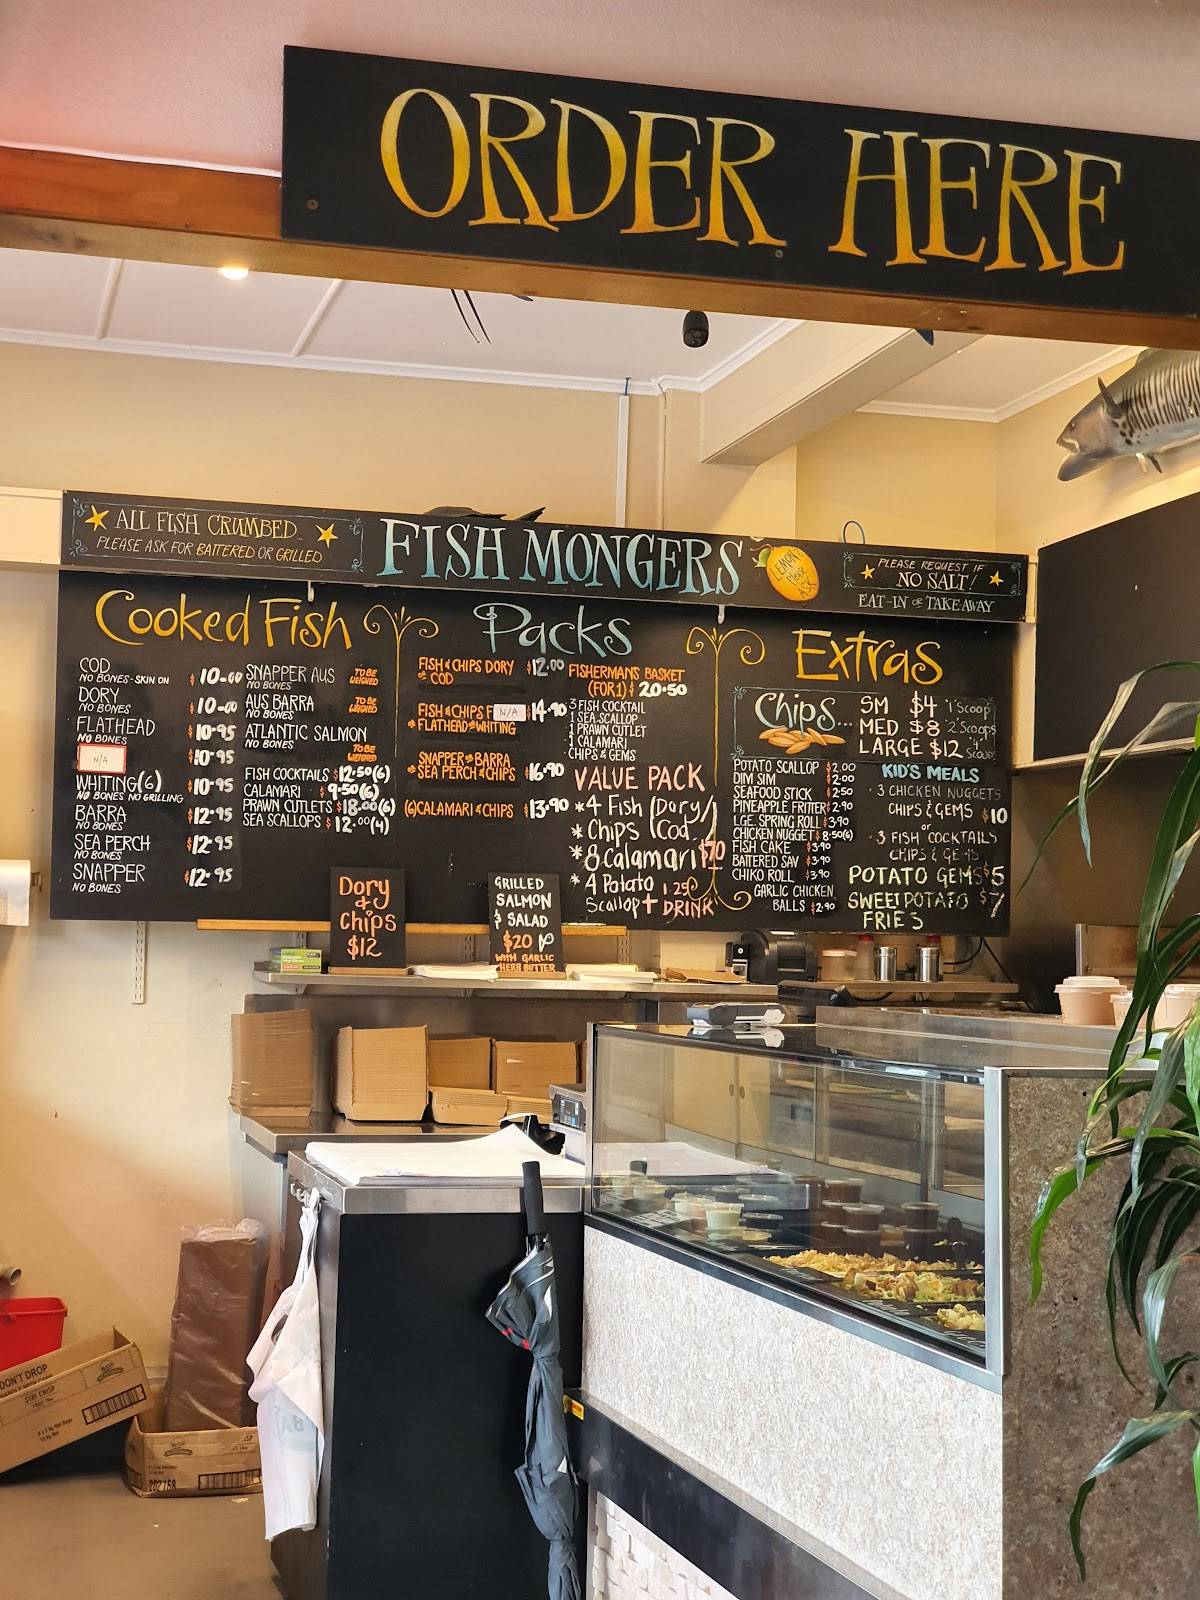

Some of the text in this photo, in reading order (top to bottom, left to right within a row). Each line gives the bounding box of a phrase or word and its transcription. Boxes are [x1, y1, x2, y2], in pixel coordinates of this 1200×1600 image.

[380, 88, 1124, 276] ORDER HERE
[115, 509, 150, 531] ALL
[157, 511, 200, 535] FISH
[97, 536, 322, 564] PLEASE ASK FOR BATTERED OR GRILLED
[376, 518, 743, 597] FISH MONGERS
[877, 558, 985, 572] PLEASE REQUEST IF
[896, 571, 976, 594] NO SALT!
[926, 596, 996, 612] TAKEAWAY
[96, 590, 352, 649] Cooked Fish
[473, 603, 632, 657] Packs
[792, 628, 943, 685] Extras
[80, 658, 110, 674] COD
[246, 664, 335, 684] SNAPPER AUS
[419, 657, 514, 676] FISH CHIPS DORY
[569, 664, 685, 682] FISHERMANS BASKET
[79, 674, 169, 684] NO ON
[263, 681, 292, 690] BONES
[431, 672, 454, 685] COD
[79, 687, 120, 703] DORY
[246, 694, 314, 711] AUS BARRA
[79, 703, 131, 714] NO BONES
[418, 703, 443, 718] FISH
[451, 705, 484, 718] CHIPS
[579, 700, 646, 714] FISH COCKTAIL
[860, 690, 938, 718] SM $4
[263, 711, 294, 720] BONES
[499, 709, 518, 717] N/A
[577, 712, 638, 725] SEA SCALLOP
[77, 715, 155, 737] FLATHEAD
[245, 724, 367, 743] ATLANTIC SALMON
[577, 724, 647, 738] PRAWN CUTLET
[859, 718, 940, 736] MED $8
[77, 733, 128, 745] NO BONES
[262, 740, 294, 749] BONES
[578, 736, 627, 749] CALAMARI
[568, 748, 636, 761] CHIPS GEMS
[859, 737, 924, 758] LARGE
[929, 739, 963, 760] $12
[94, 754, 108, 764] N/A
[474, 752, 511, 767] BARRA
[733, 759, 819, 775] POTATO SCALLOP
[245, 767, 330, 782] FISH COCKTAILS
[418, 765, 516, 781] SEA PERCH CHIPS
[575, 762, 705, 792] VALUE PACK
[733, 772, 776, 788] DIM SIM
[926, 768, 980, 783] MEALS
[93, 792, 184, 803] BONES NO GRILLING
[244, 783, 300, 798] CALAMARI
[733, 785, 812, 801] SEAFOOD STICK
[889, 785, 941, 797] CHICKEN
[75, 804, 127, 822] BARRA
[243, 799, 333, 813] PRAWN CUTLETS
[482, 804, 514, 818] CHIPS
[608, 794, 642, 817] Fish
[733, 800, 788, 813] PINEAPPLE
[888, 802, 973, 821] CHIPS GEMS
[76, 822, 123, 831] NO BONES
[243, 813, 321, 828] SEA SCALLOPS
[759, 814, 821, 829] SPRING ROLL
[588, 819, 640, 848] Chips
[733, 827, 815, 842] CHICKEN NUGGET
[891, 831, 919, 845] FISH
[74, 833, 151, 851] SEA PERCH
[732, 840, 791, 854] FISH CAKE
[74, 850, 122, 861] NO BONES
[732, 854, 799, 868] BATTERED SAV
[72, 863, 146, 882] SNAPPER
[732, 868, 795, 882] CHIKO ROLL
[849, 865, 928, 886] POTATO
[72, 883, 121, 894] NO BONES
[494, 876, 544, 890] GRILLED
[602, 872, 654, 894] Potato
[339, 876, 390, 910] Dory
[754, 884, 834, 899] GARLIC CHICKEN
[496, 892, 551, 910] SALMON
[586, 896, 640, 919] Scallop
[663, 896, 714, 918] DRINK
[773, 899, 805, 912] BALLS
[847, 892, 900, 910] SWEET
[980, 888, 1004, 918] $7
[340, 910, 397, 937] Chips
[507, 912, 548, 928] SALAD
[863, 911, 924, 930] FRIES
[347, 935, 382, 960] $12
[503, 930, 533, 953] $20
[495, 953, 517, 962] WITH
[524, 963, 556, 972] BUTTER
[0, 1373, 23, 1390] DON'T
[24, 1364, 48, 1378] DROP
